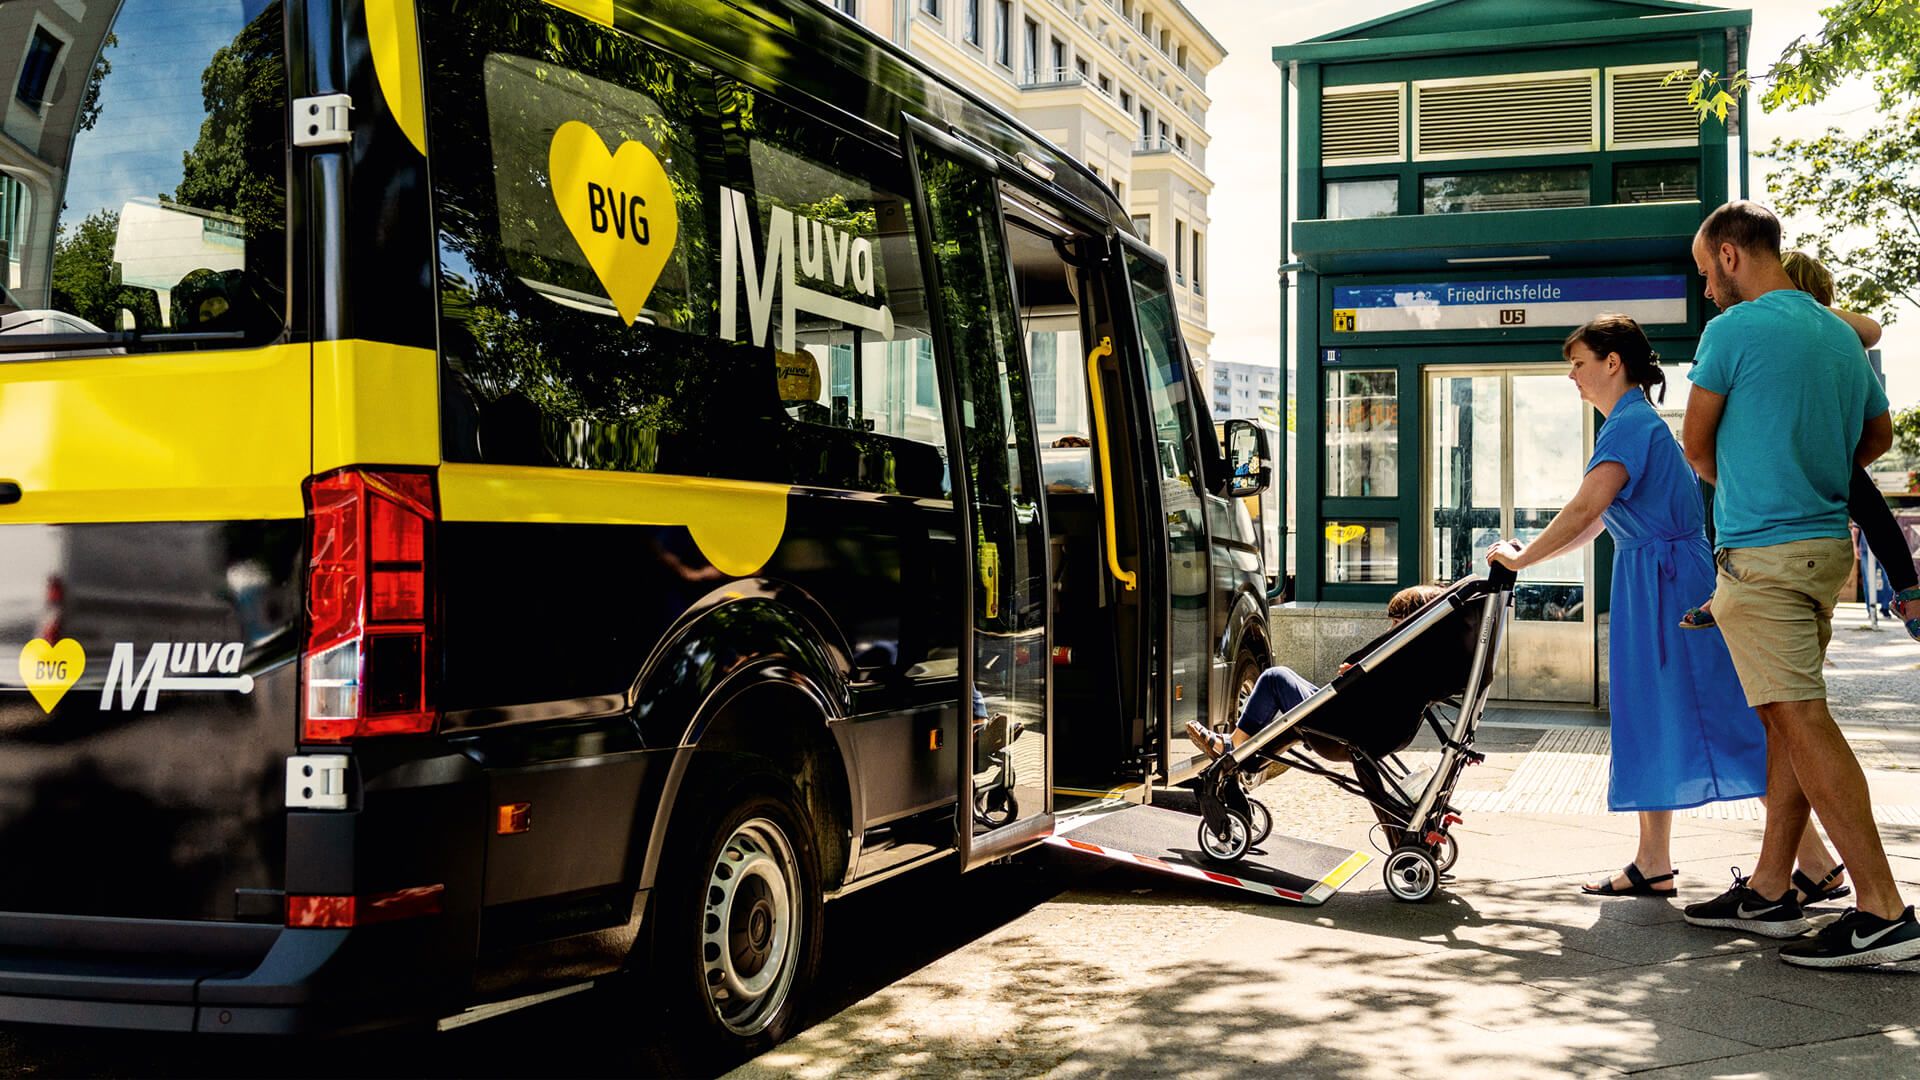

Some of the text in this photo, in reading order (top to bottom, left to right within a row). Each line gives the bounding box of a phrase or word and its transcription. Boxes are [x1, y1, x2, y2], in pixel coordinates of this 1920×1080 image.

[587, 182, 650, 246] BVG
[719, 185, 895, 355] Muva
[1447, 284, 1561, 302] Friedrichsfelde
[1502, 310, 1524, 324] U5
[35, 660, 67, 680] BVG
[99, 642, 255, 711] Muva
